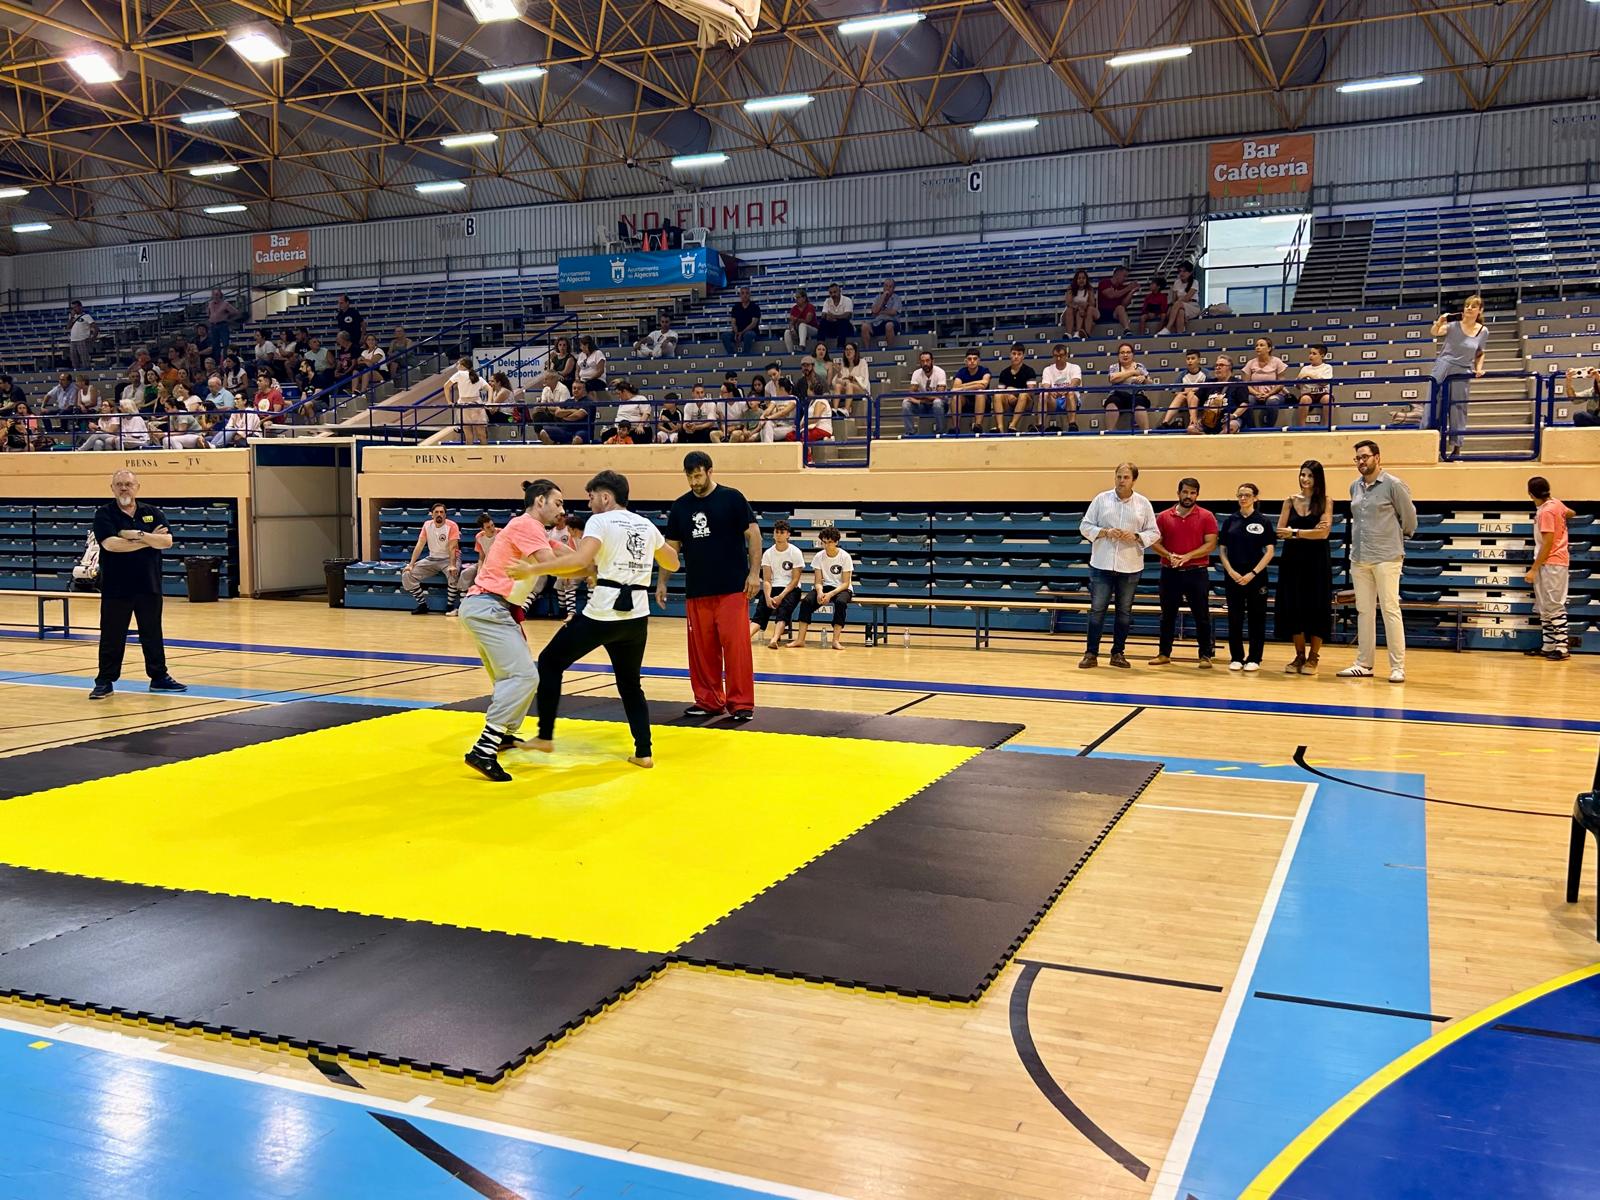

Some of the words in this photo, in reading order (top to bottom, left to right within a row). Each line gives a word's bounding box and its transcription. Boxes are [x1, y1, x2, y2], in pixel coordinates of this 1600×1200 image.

[1242, 141, 1280, 160] Bar
[1214, 157, 1308, 181] Cafetería
[969, 172, 981, 192] C
[621, 211, 659, 234] NO
[677, 199, 789, 231] FUMAR
[466, 218, 475, 236] B
[270, 235, 291, 248] Bar
[141, 246, 149, 262] A
[255, 246, 307, 263] Cafetería
[566, 276, 591, 284] Algeciras
[634, 271, 660, 280] Algeciras
[125, 459, 159, 468] PRENSA
[188, 457, 200, 466] TV
[416, 455, 455, 464] PRENSA
[493, 454, 506, 464] TV
[1479, 523, 1502, 532] FILA
[1505, 524, 1511, 533] 5
[1498, 550, 1505, 558] 4
[1502, 576, 1509, 585] 3
[1484, 603, 1500, 612] ILA
[1503, 604, 1509, 613] 2
